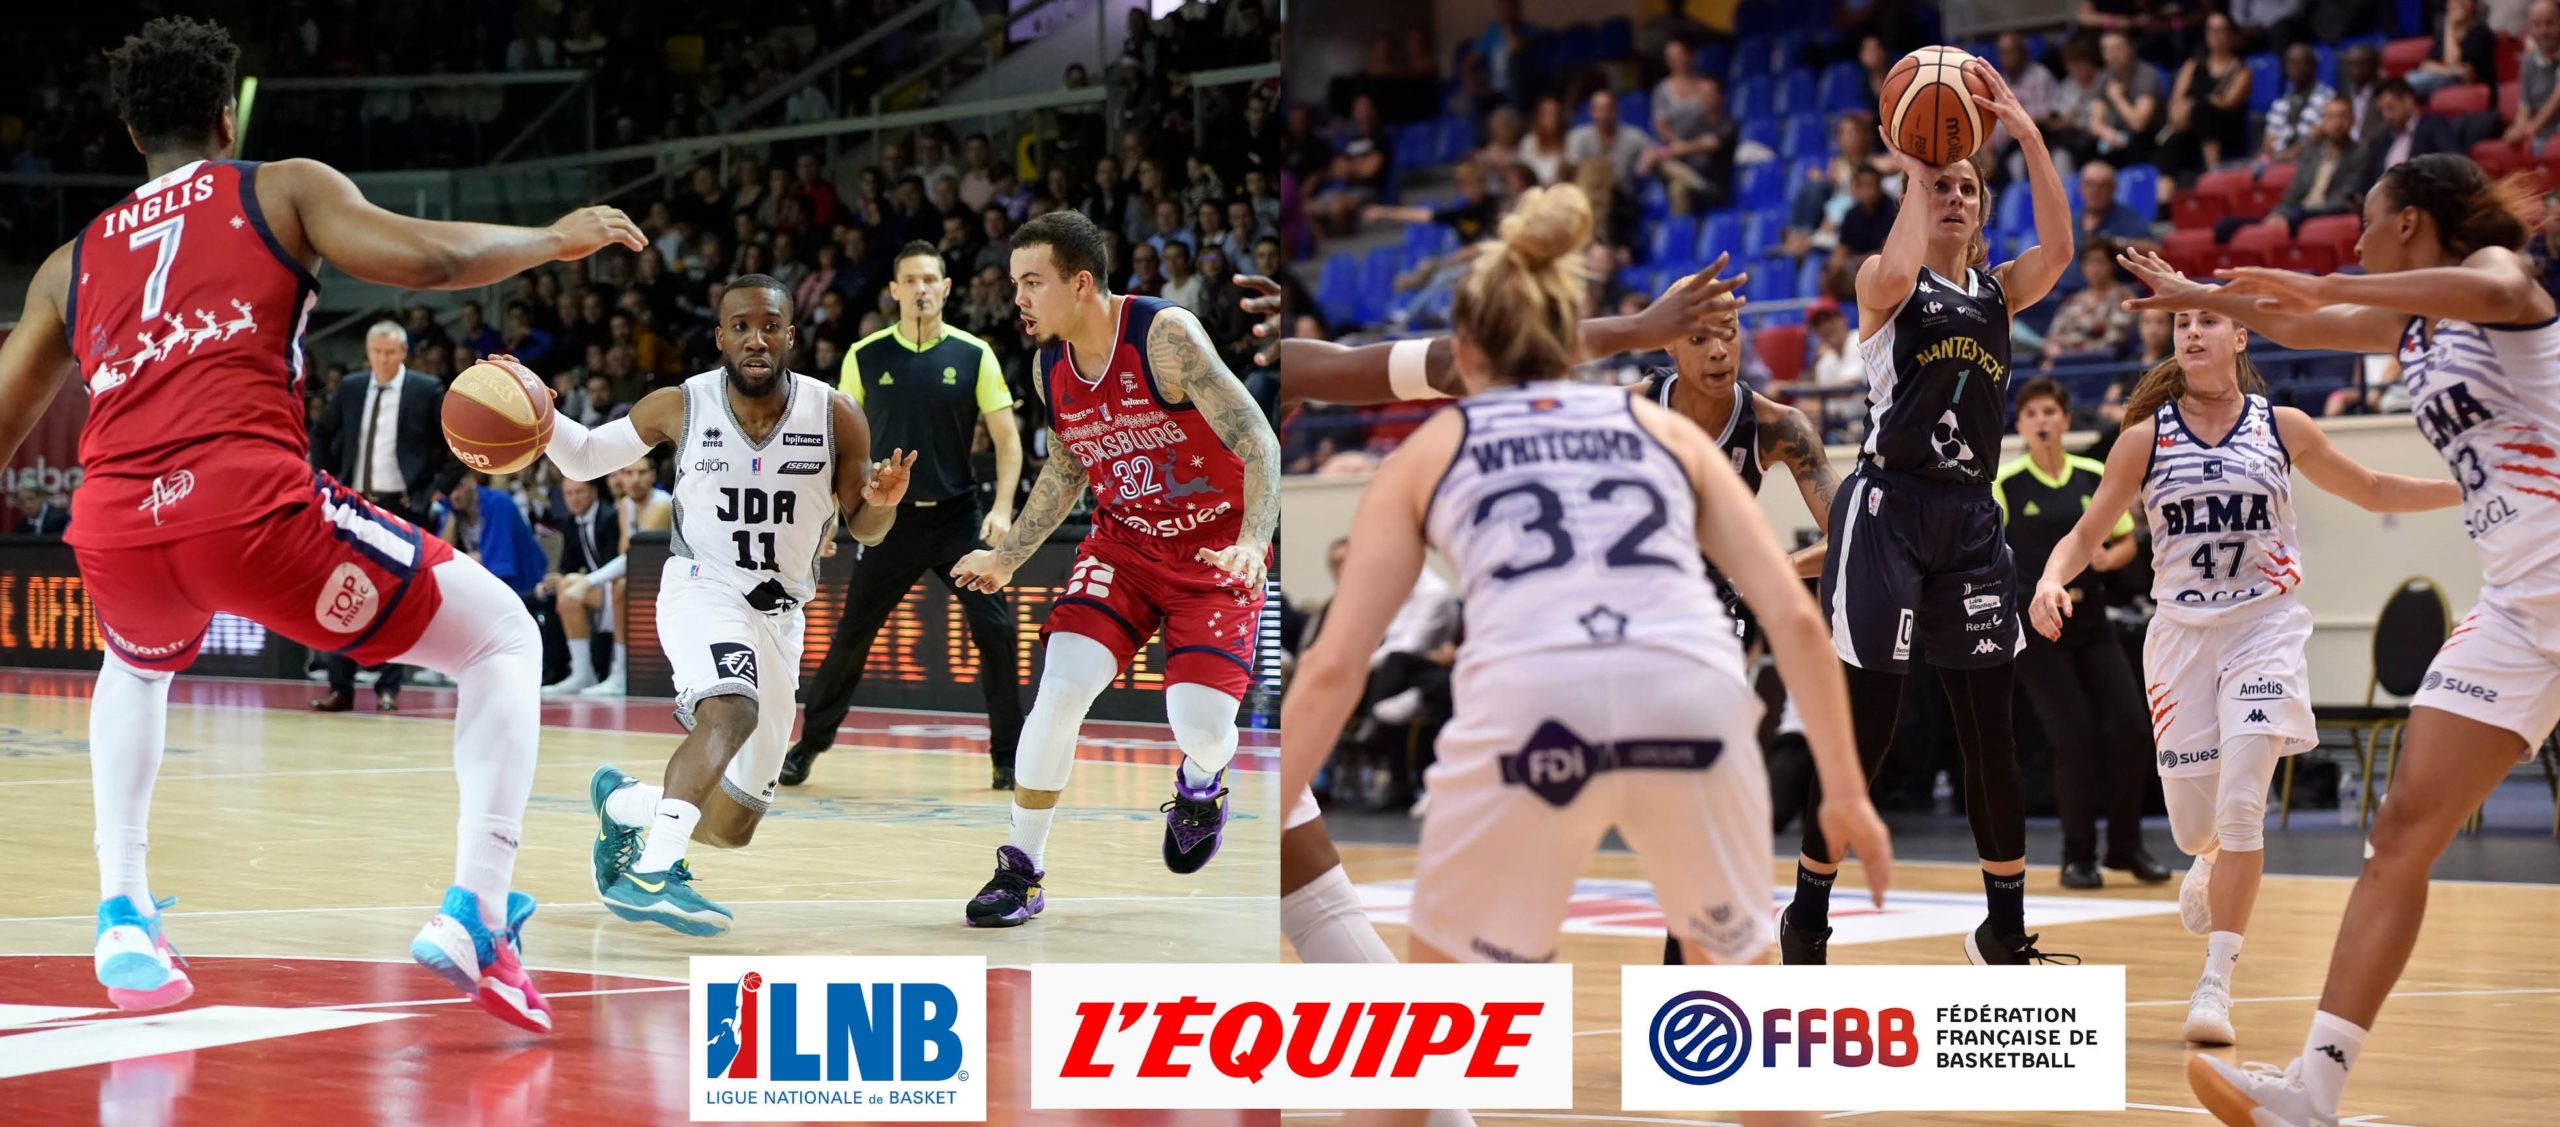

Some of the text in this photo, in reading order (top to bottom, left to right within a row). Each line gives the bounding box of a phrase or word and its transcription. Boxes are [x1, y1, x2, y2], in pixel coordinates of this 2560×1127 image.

[103, 174, 214, 238] INGLIS
[129, 213, 185, 323] 7
[1952, 369, 1970, 404] 1
[785, 435, 822, 446] bpifrance
[1472, 429, 1644, 474] WHITCOMB
[786, 462, 820, 470] ISERBA
[1112, 456, 1162, 500] 32
[715, 487, 796, 525] JDA
[2162, 494, 2271, 536] BLMA
[1473, 479, 1685, 580] 32
[732, 530, 781, 573] 11
[2189, 539, 2248, 581] 47
[326, 575, 356, 620] TOP
[341, 585, 370, 627] music
[1966, 619, 1992, 632] Rezé
[2443, 678, 2498, 703] suez
[2179, 749, 2219, 764] suez
